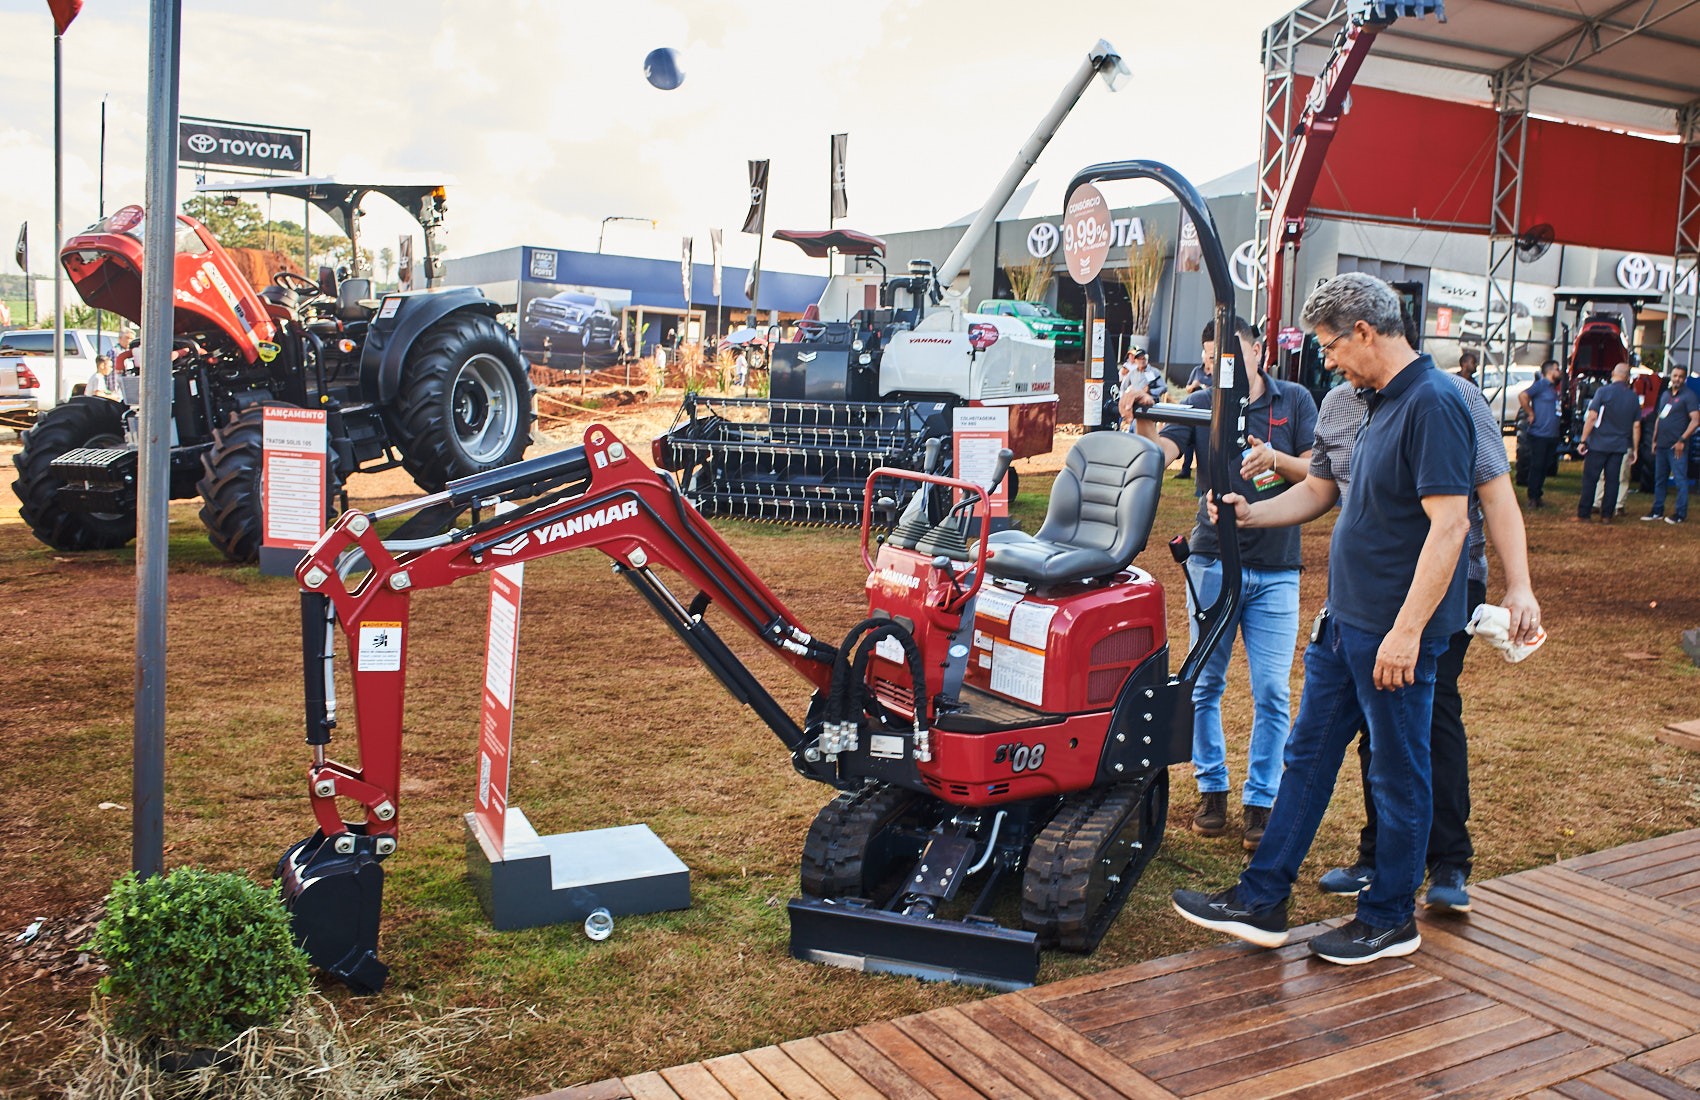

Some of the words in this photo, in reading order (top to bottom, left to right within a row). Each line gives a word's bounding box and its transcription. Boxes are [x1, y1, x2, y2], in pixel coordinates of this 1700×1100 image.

[219, 138, 294, 160] TOYOTA
[908, 337, 952, 345] YANMAR
[265, 408, 324, 420] LANÇAMENTO
[532, 499, 639, 545] YANMAR
[881, 568, 920, 589] YANMAR
